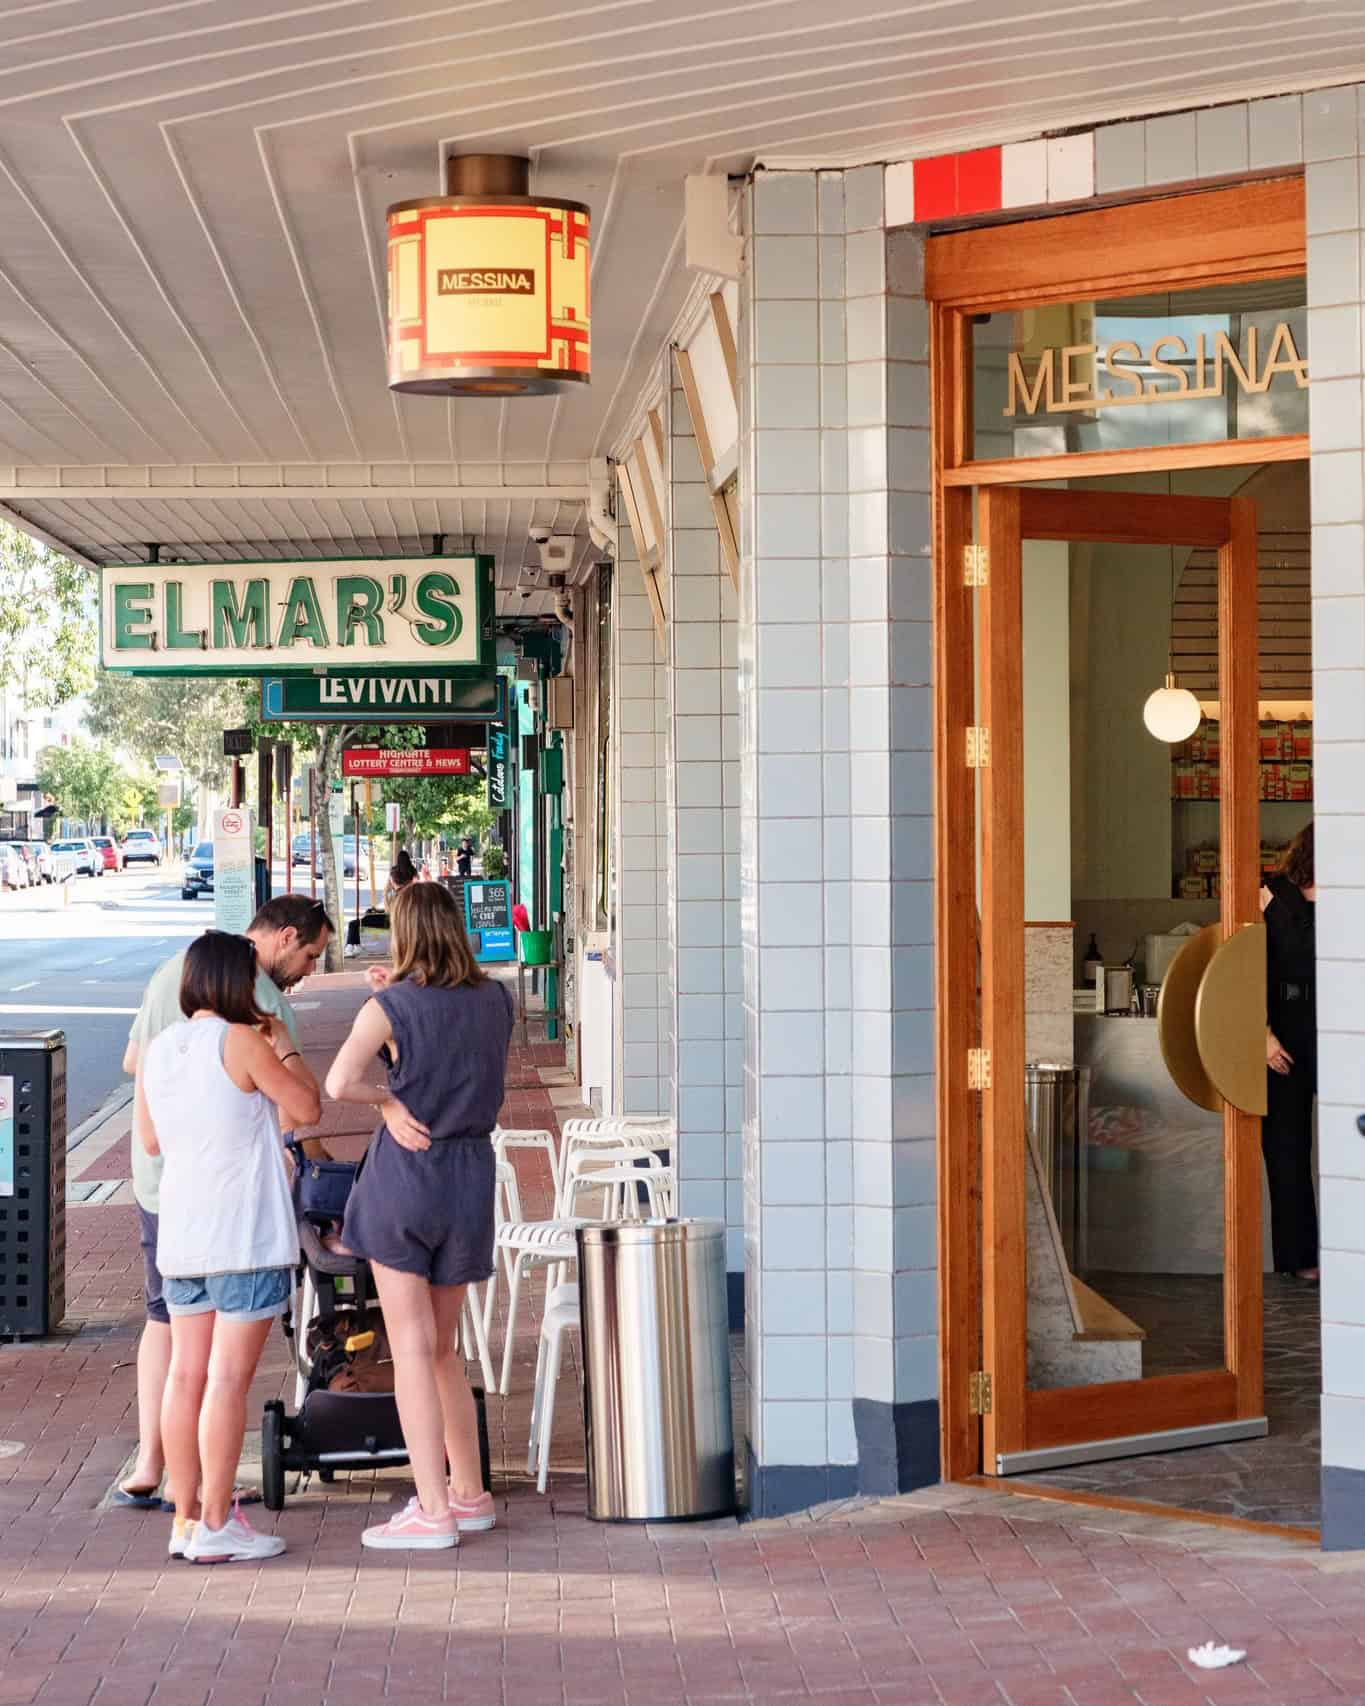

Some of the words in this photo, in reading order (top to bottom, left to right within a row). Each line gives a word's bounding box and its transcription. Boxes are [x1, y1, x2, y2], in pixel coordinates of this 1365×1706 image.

[442, 272, 531, 290] MESSINA
[1003, 321, 1308, 417] MESSINA
[109, 572, 465, 653] ELMAR'S
[348, 759, 389, 768] LOTTERY
[390, 759, 424, 768] CENTRE
[435, 759, 462, 768] NEWS
